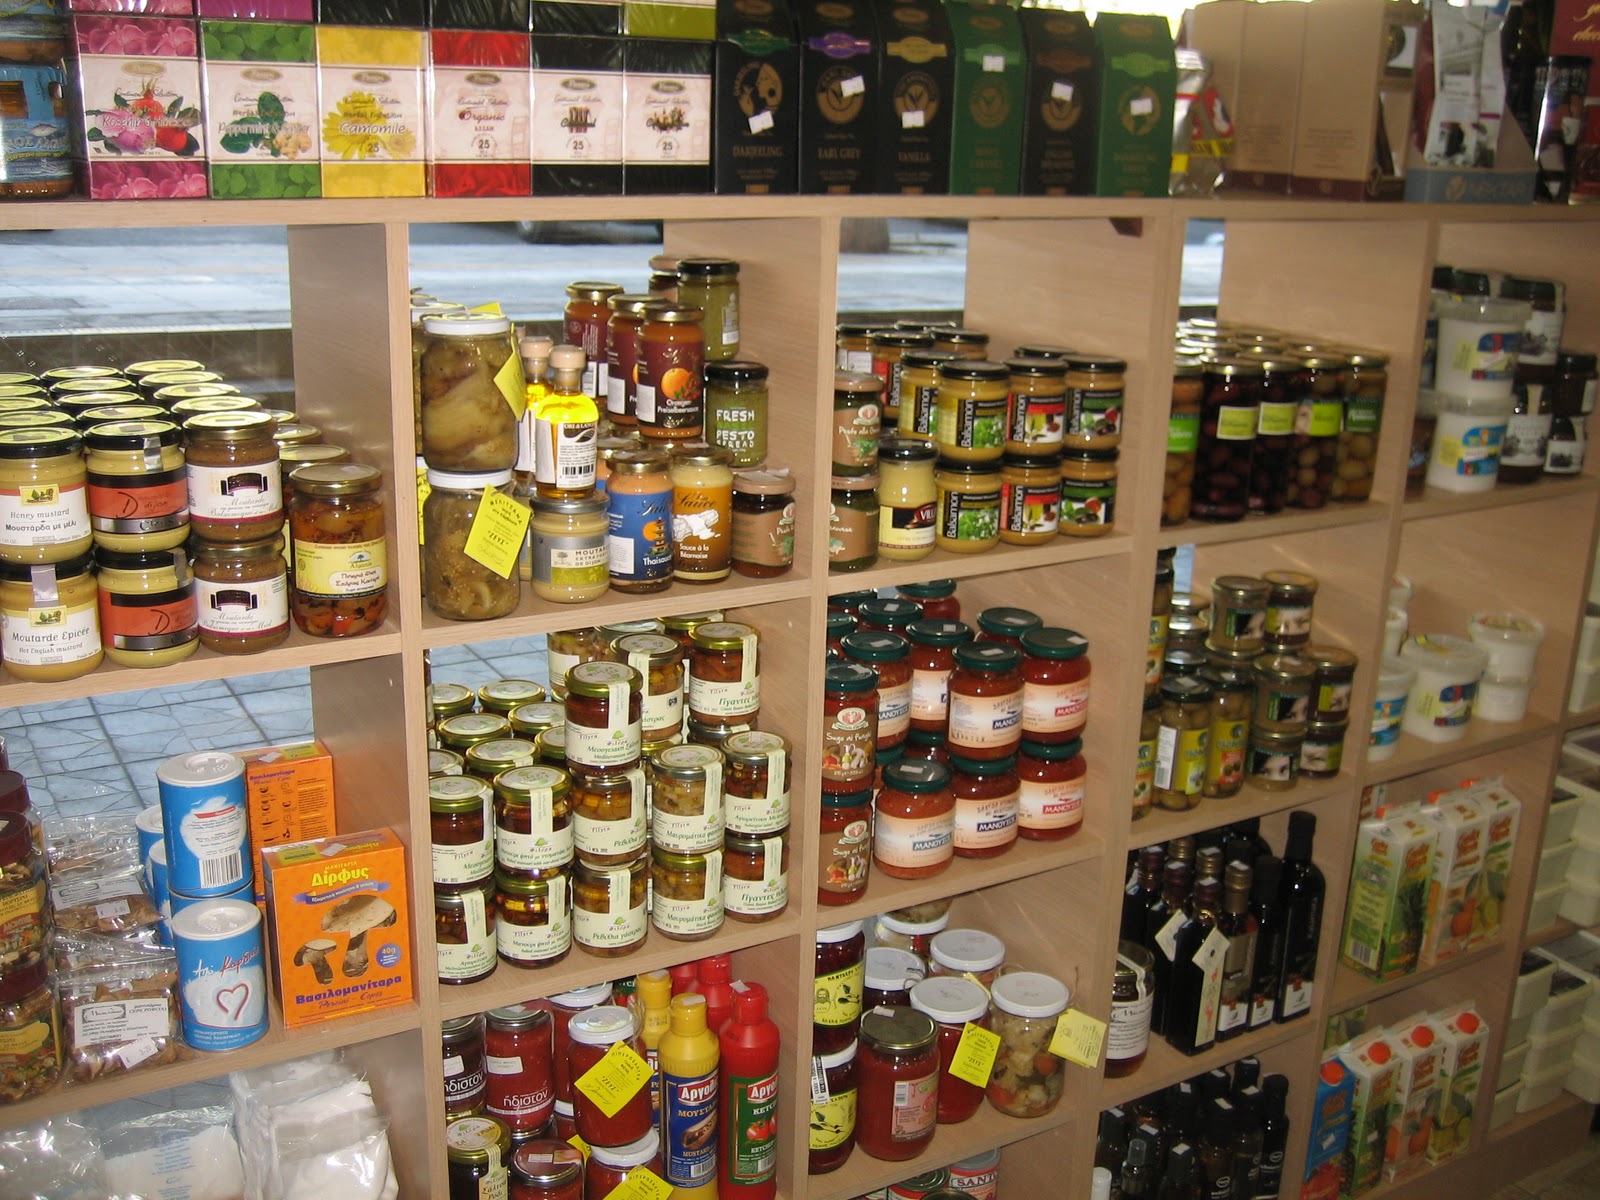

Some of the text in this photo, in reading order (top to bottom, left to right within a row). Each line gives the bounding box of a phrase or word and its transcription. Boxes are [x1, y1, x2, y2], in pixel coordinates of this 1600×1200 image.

[102, 114, 142, 128] Rosehip
[461, 108, 506, 122] Organic
[338, 121, 406, 136] Camomile
[367, 143, 380, 153] 25
[478, 139, 490, 150] 25
[573, 140, 585, 151] 25
[662, 141, 674, 152] 25
[732, 145, 784, 159] DARJEELING
[817, 148, 862, 160] EARL GREY
[898, 151, 931, 164] VANILLA
[716, 408, 756, 422] FRESH
[917, 387, 931, 433] Balsamon
[961, 399, 974, 448] Balsamon
[1014, 394, 1027, 442] Balsamon
[716, 429, 756, 440] PESTO
[225, 496, 266, 507] Moutarde
[10, 508, 71, 521] Honey mustard
[946, 491, 959, 539] Balsamon
[1011, 485, 1024, 532] Balsamon
[5, 520, 78, 533] Μουστάρδα με μέλι
[679, 542, 697, 551] Sauce
[702, 543, 710, 551] la
[679, 550, 709, 560] Béarnaise
[12, 626, 91, 643] Moutarde Epicée
[30, 646, 56, 656] English
[56, 642, 84, 654] mustard
[641, 715, 665, 723] άστρας
[826, 732, 846, 745] Sugo
[832, 847, 852, 859] Sugo
[324, 860, 358, 871] ΜΑΝΙΤΑΡΙΑ
[311, 866, 371, 887] Δίρφυς
[741, 893, 775, 902] Γίγαντες
[382, 947, 397, 956] 40g
[294, 975, 402, 1006] Βασιλομανίταρα
